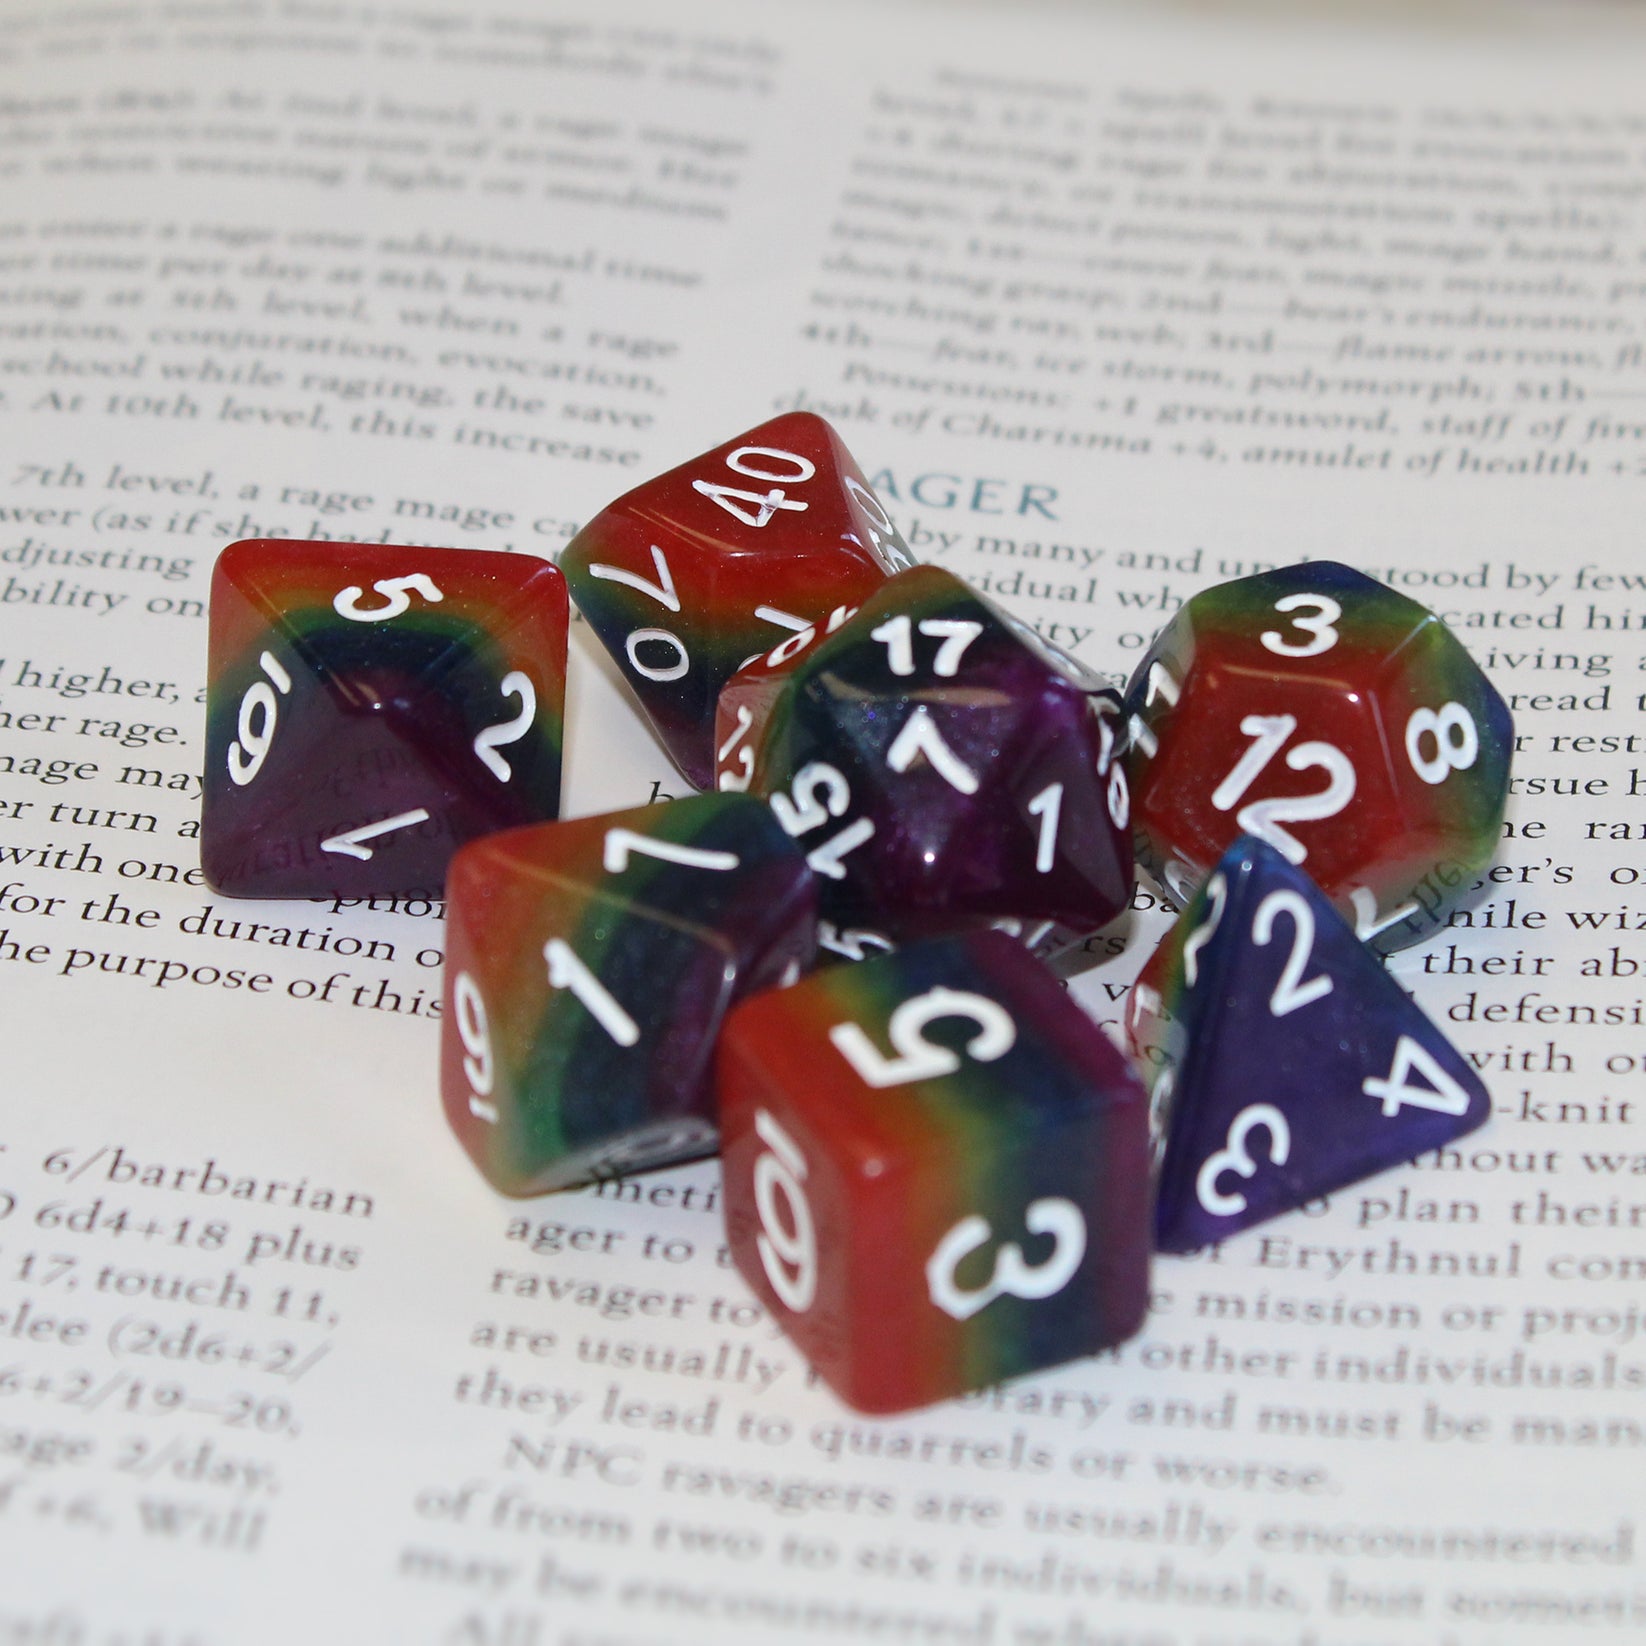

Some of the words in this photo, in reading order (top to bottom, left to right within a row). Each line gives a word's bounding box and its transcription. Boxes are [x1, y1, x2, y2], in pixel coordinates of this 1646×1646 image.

[437, 350, 667, 397] evocation,
[31, 391, 84, 414] At
[218, 396, 334, 432] level,
[349, 409, 438, 440] this
[453, 423, 643, 467] increase
[473, 385, 547, 414] the
[561, 404, 655, 430] save
[1420, 408, 1512, 440] staff
[1530, 411, 1572, 442] of
[893, 406, 929, 433] of
[942, 411, 1153, 455] Charisma
[1243, 440, 1393, 472] amulet
[1405, 451, 1444, 477] of
[1456, 449, 1591, 476] health
[11, 463, 85, 489] 7th
[103, 466, 219, 500] level,
[238, 481, 260, 500] a
[279, 485, 375, 514] rage
[395, 497, 516, 530] mage
[692, 446, 816, 527] 40
[92, 504, 153, 533] (as
[167, 508, 212, 535] if
[212, 514, 290, 539] she
[909, 520, 963, 556] by
[974, 530, 1105, 565] many
[1116, 549, 1203, 577] and
[1505, 564, 1560, 595] by
[1573, 564, 1646, 592] few
[2, 577, 129, 617] bility
[333, 572, 444, 623] 5
[1260, 593, 1342, 657] 3
[871, 616, 984, 677] 17
[12, 660, 180, 704] higher,
[75, 716, 187, 748] rage.
[473, 670, 537, 782] 2
[1406, 701, 1478, 784] 8
[50, 802, 165, 833] turn
[177, 817, 200, 838] a
[1212, 713, 1356, 865] 12
[1029, 783, 1063, 873] 1
[0, 843, 102, 874] with
[118, 857, 205, 887] one
[0, 882, 65, 917] for
[80, 893, 161, 929] the
[179, 906, 396, 963] duration
[1252, 889, 1333, 1016] 2
[58, 947, 273, 993] purpose
[287, 972, 351, 1003] of
[352, 980, 443, 1019] this
[543, 937, 639, 1046] 1
[1422, 945, 1555, 977] their
[829, 986, 1017, 1088] 5
[1449, 992, 1646, 1026] defensi
[1363, 1035, 1470, 1116] 4
[42, 1145, 376, 1219] 6/barbarian
[1195, 1102, 1290, 1218] 3
[34, 1199, 229, 1251] 6d4+18
[245, 1225, 364, 1270] plus
[504, 1215, 625, 1256] ager
[641, 1233, 695, 1265] to
[1358, 1188, 1480, 1229] plan
[96, 1264, 250, 1311] touch
[925, 1196, 1087, 1320] 3
[1257, 1235, 1521, 1282] Erythnul
[490, 1265, 698, 1321] ravager
[709, 1296, 766, 1329] to
[1195, 1284, 1422, 1330] mission
[1441, 1302, 1506, 1331] or
[470, 1320, 558, 1358] are
[577, 1333, 787, 1394] usually
[1138, 1332, 1299, 1377] other
[1313, 1343, 1646, 1390] individuals
[454, 1365, 584, 1428] they
[600, 1382, 721, 1439] lead
[737, 1408, 794, 1447] to
[809, 1420, 1056, 1474] quarrels
[1070, 1448, 1134, 1480] or
[1126, 1391, 1237, 1429] and
[1258, 1402, 1402, 1440] must
[1423, 1400, 1494, 1443] be
[504, 1432, 646, 1487] NPC
[661, 1461, 896, 1515] ravagers
[912, 1496, 1003, 1530] are
